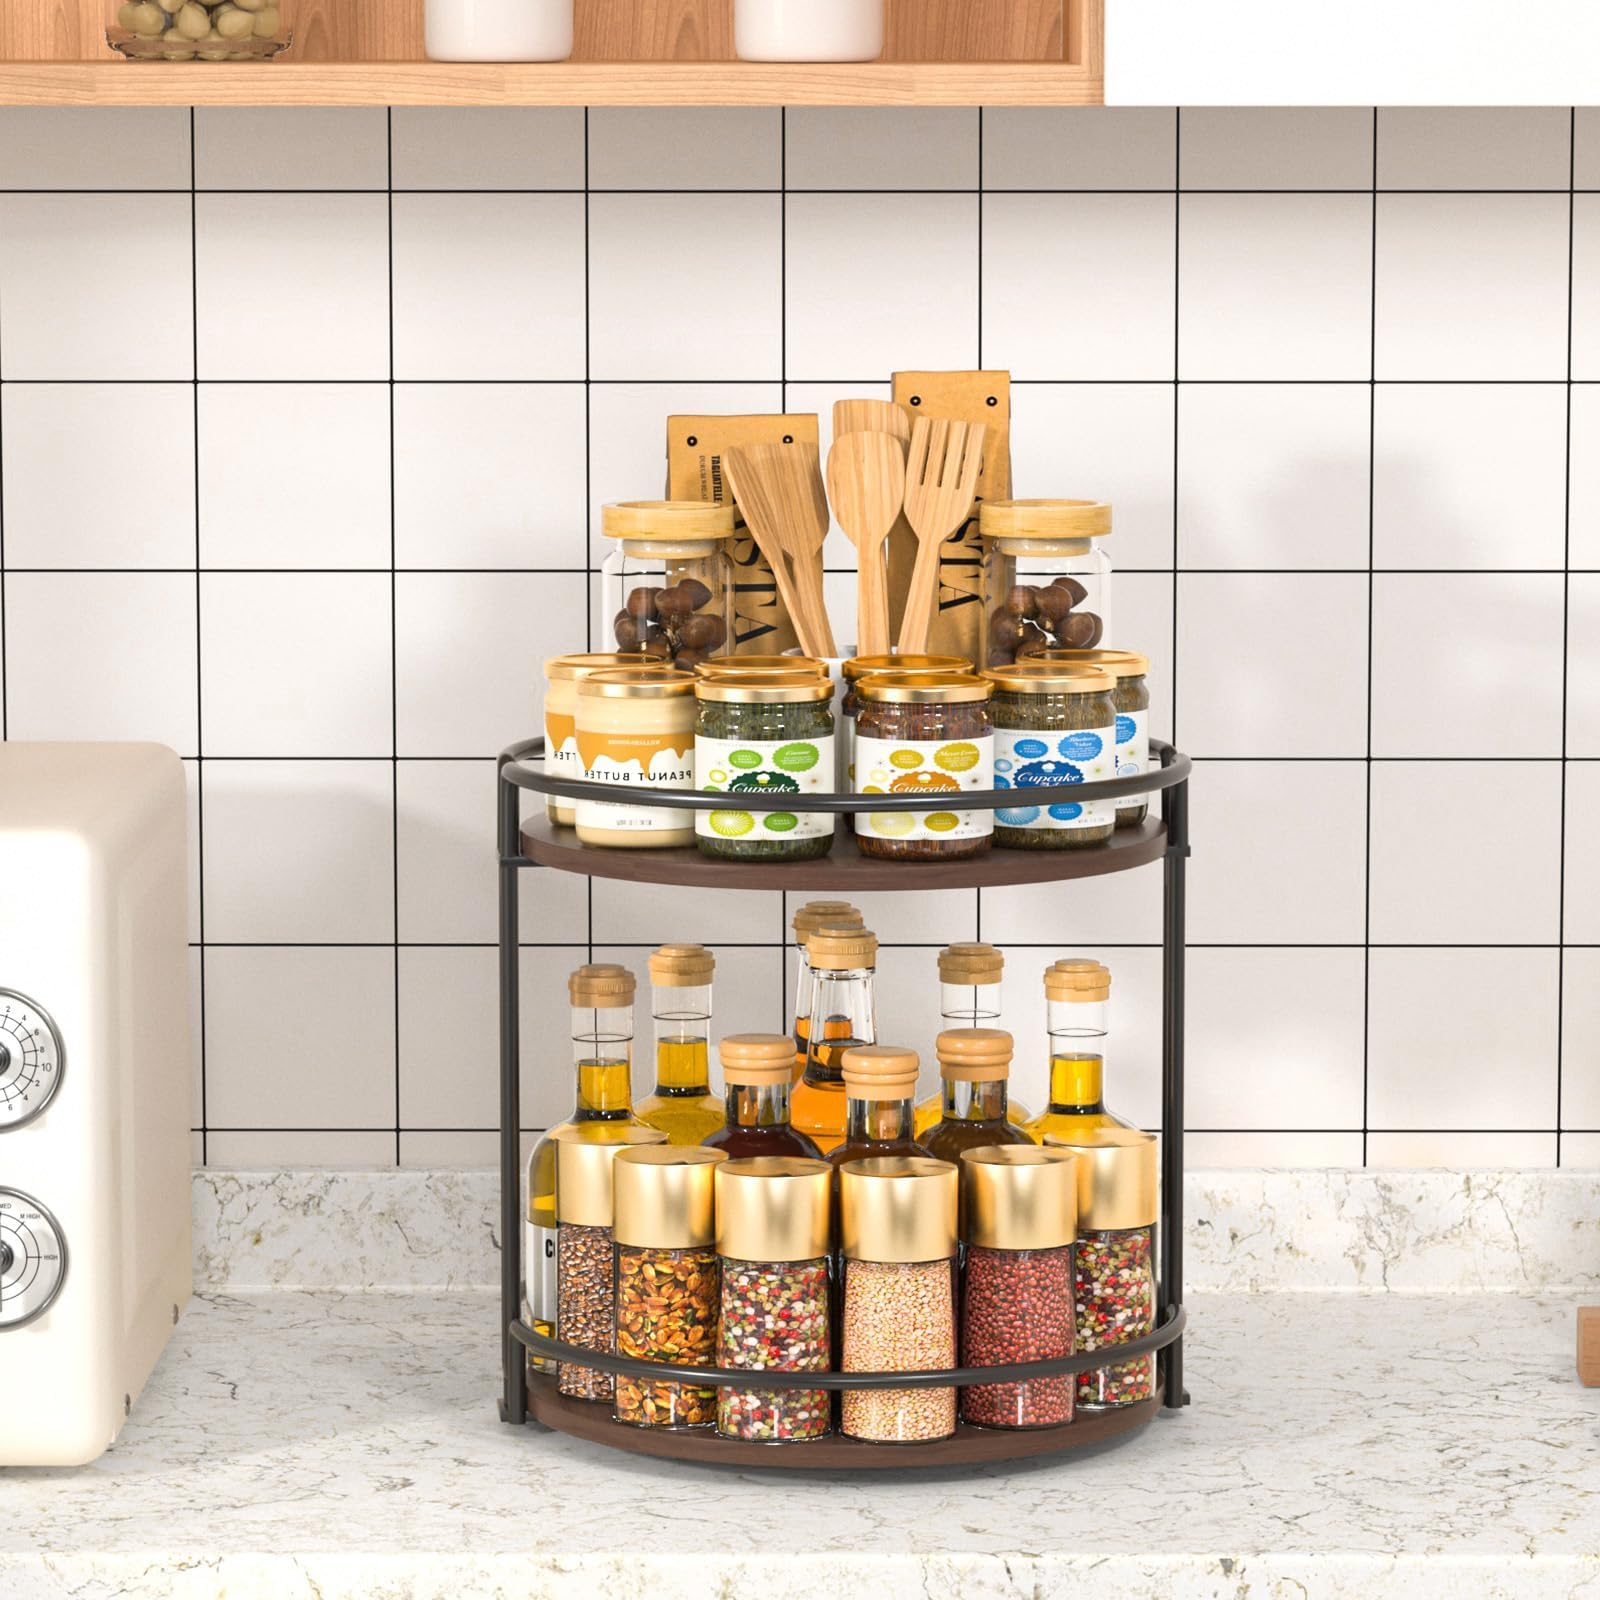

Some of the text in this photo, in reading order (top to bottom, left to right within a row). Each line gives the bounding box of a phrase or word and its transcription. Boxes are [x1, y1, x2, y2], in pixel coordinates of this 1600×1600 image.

[711, 454, 724, 504] TAGLIATELLE
[1016, 771, 1080, 786] Cupcake
[731, 782, 796, 793] Cupcake
[892, 782, 957, 793] Cupcake
[5, 1005, 11, 1013] 2
[34, 1028, 40, 1036] 6
[42, 1062, 52, 1072] 10
[34, 1079, 40, 1087] 2
[8, 1103, 13, 1111] 6
